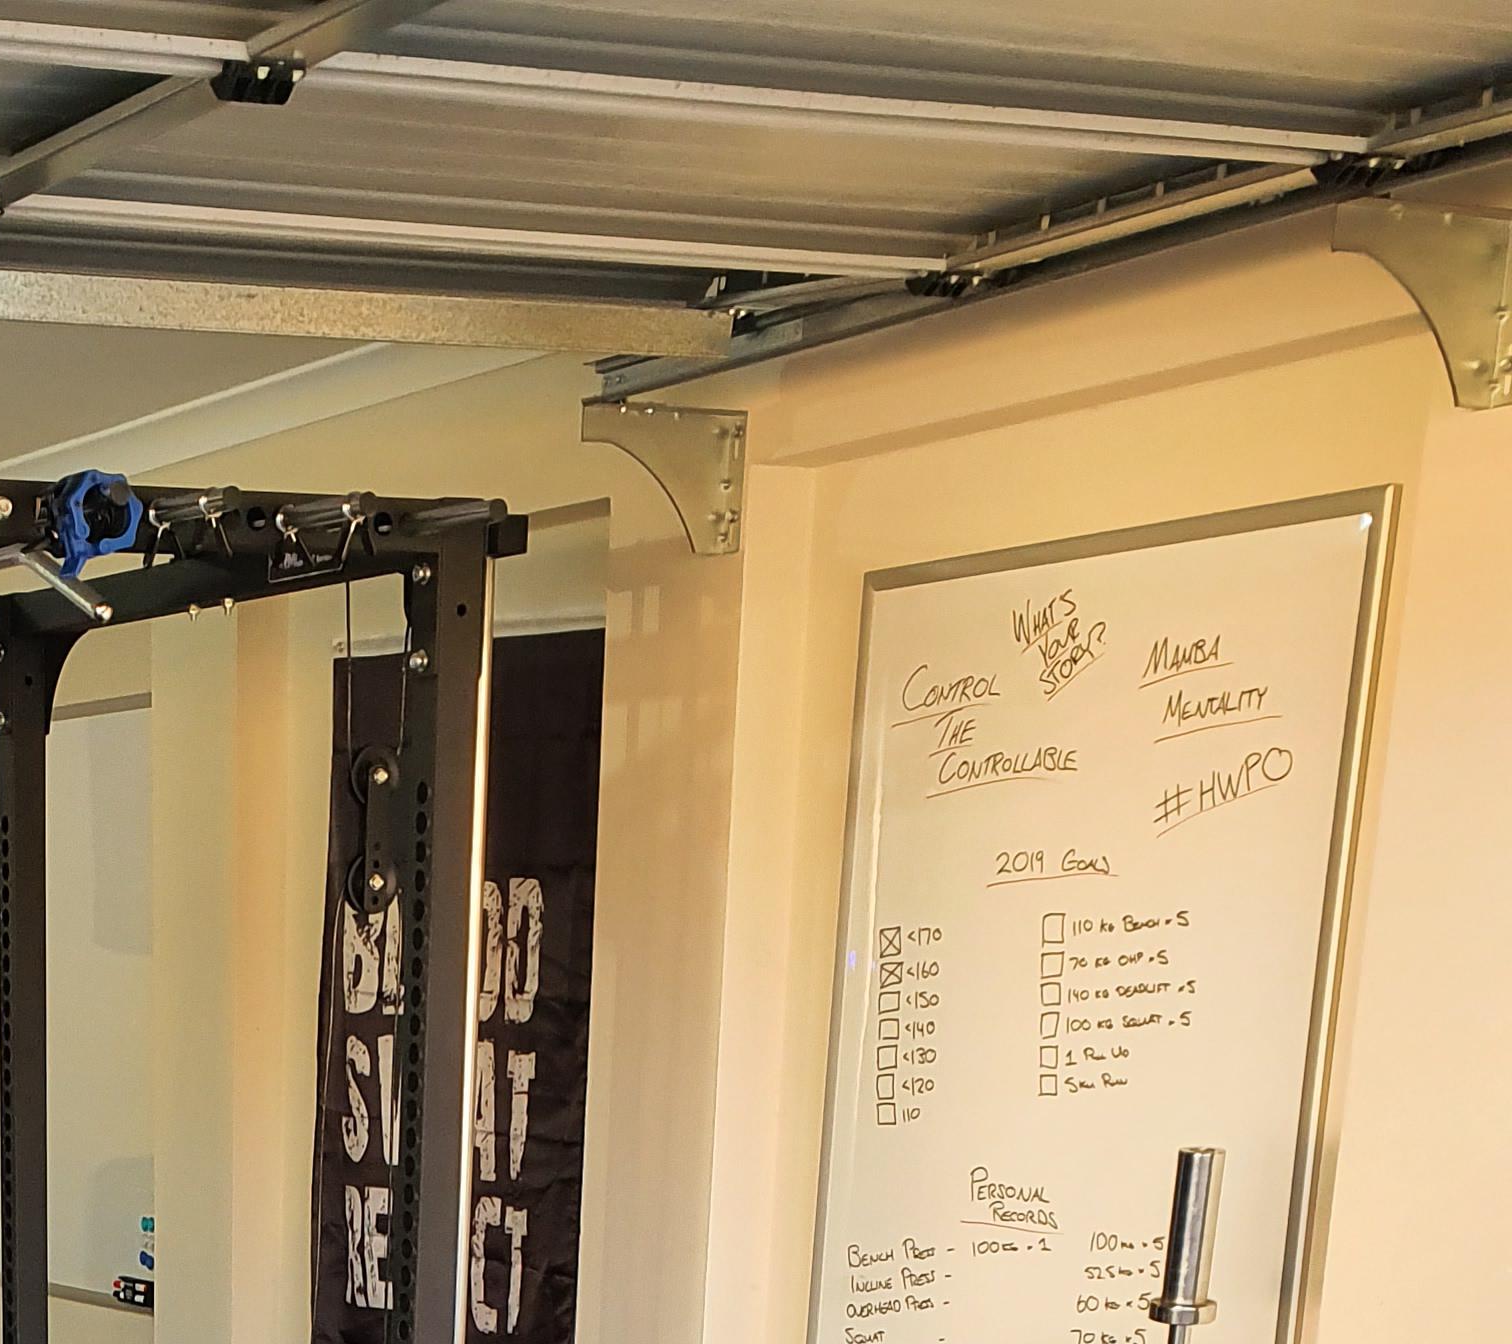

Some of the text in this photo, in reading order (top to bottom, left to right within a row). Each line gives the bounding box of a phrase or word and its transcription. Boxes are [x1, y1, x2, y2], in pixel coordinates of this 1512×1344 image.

[1142, 635, 1221, 679] MAMBA
[902, 664, 1001, 711] CONTROL
[1163, 686, 1269, 727] MENTALITY
[935, 715, 976, 748] THE
[939, 746, 1078, 786] CONTROLLABLE
[1153, 748, 1294, 823] #HWPO
[995, 851, 1043, 875] 2019
[907, 927, 942, 946] <170
[1073, 919, 1093, 936] 110
[906, 961, 939, 980] <160
[1069, 956, 1088, 970] 70
[1118, 951, 1144, 967] OHP
[906, 991, 939, 1009] <150
[1067, 987, 1089, 1003] 140
[1115, 982, 1171, 998] DEADLIFT
[905, 1021, 936, 1040] <140
[1066, 1016, 1092, 1034] 100
[1122, 1013, 1163, 1028] SQUAT
[902, 1047, 937, 1065] <130
[1065, 1049, 1077, 1066] 1
[902, 1077, 935, 1096] <120
[902, 1107, 921, 1123] 110
[970, 1166, 1050, 1203] PERSONAL
[989, 1200, 1058, 1230] RECORDS
[847, 1244, 894, 1268] BENCH
[902, 1237, 936, 1260] PRESS
[851, 1274, 893, 1294] INCLINE
[901, 1267, 936, 1290] PRESS
[846, 1299, 901, 1319] OVERHEAD
[905, 1295, 935, 1312] PRESS
[845, 1327, 885, 1344] SQUAT
